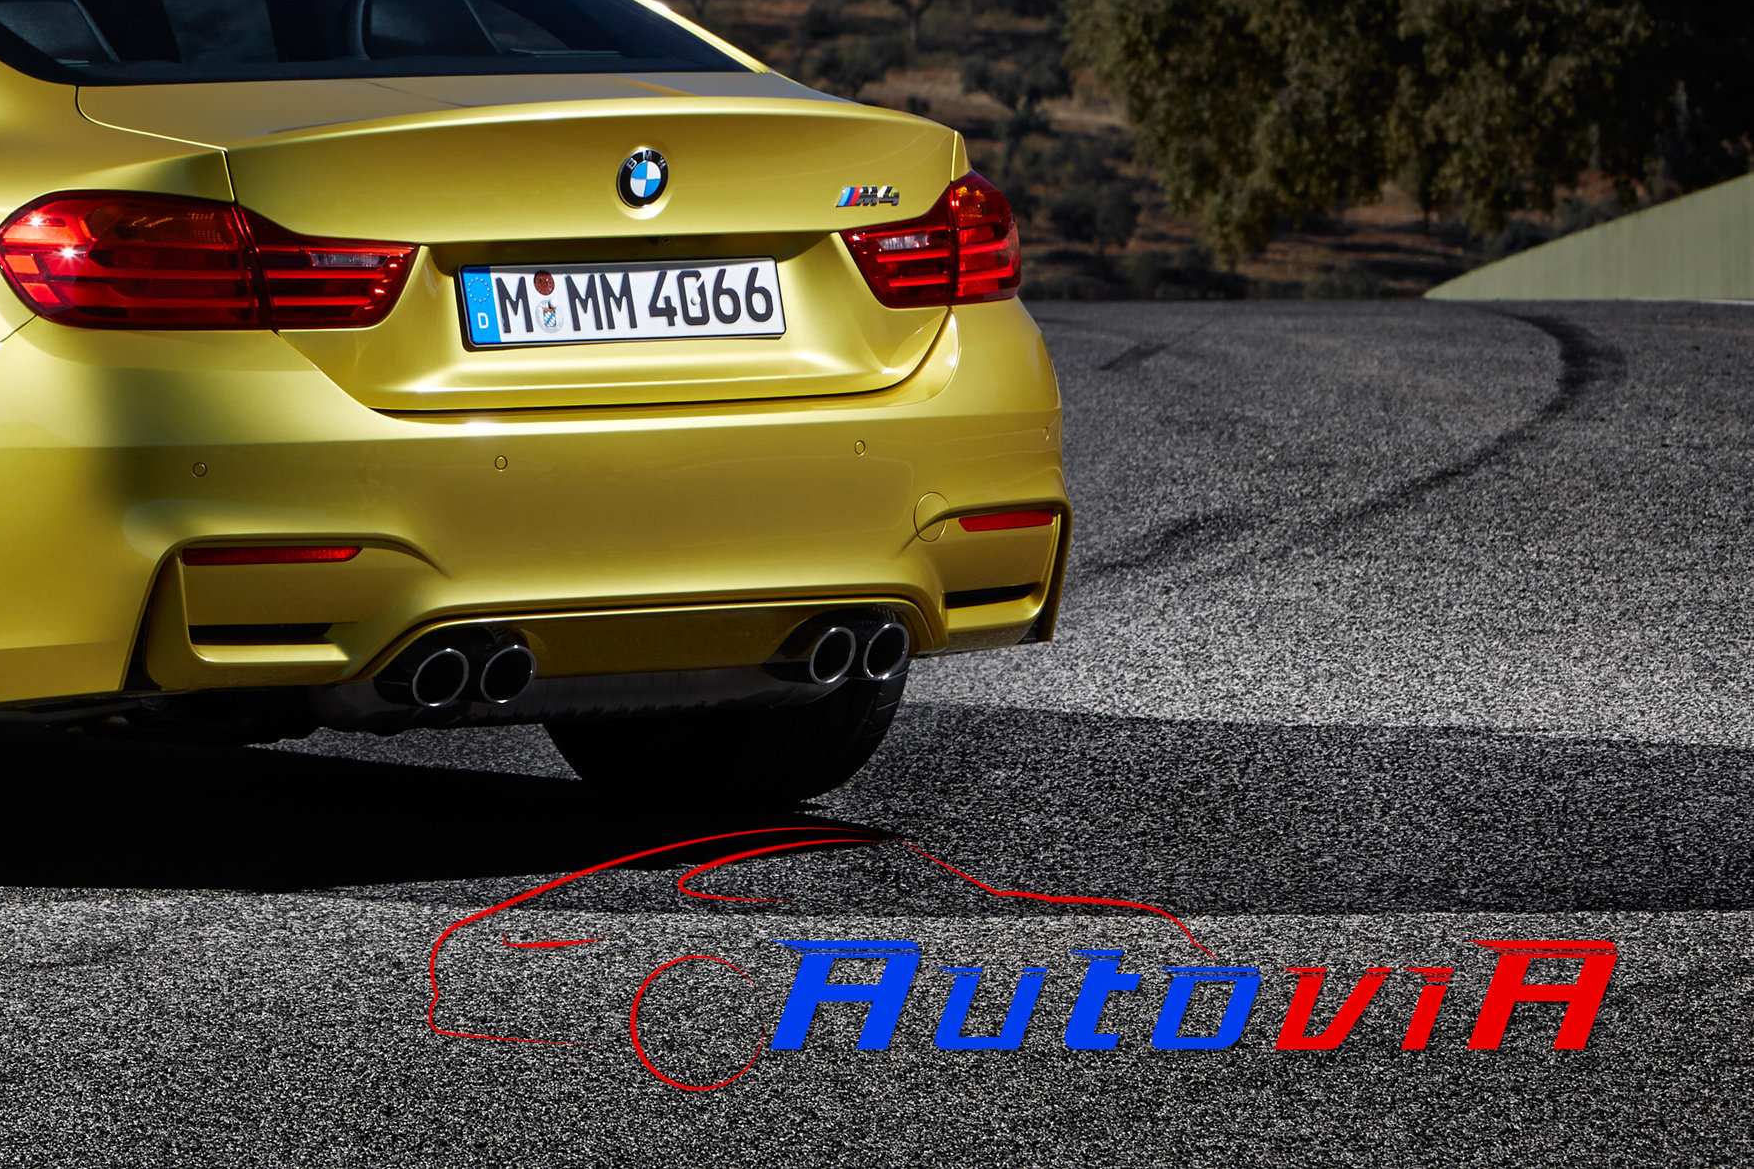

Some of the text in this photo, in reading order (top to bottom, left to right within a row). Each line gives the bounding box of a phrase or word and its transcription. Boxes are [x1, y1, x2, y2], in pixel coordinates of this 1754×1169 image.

[626, 150, 667, 170] BMW
[852, 186, 900, 207] M4
[496, 266, 774, 333] M MM 4066
[477, 312, 489, 329] D
